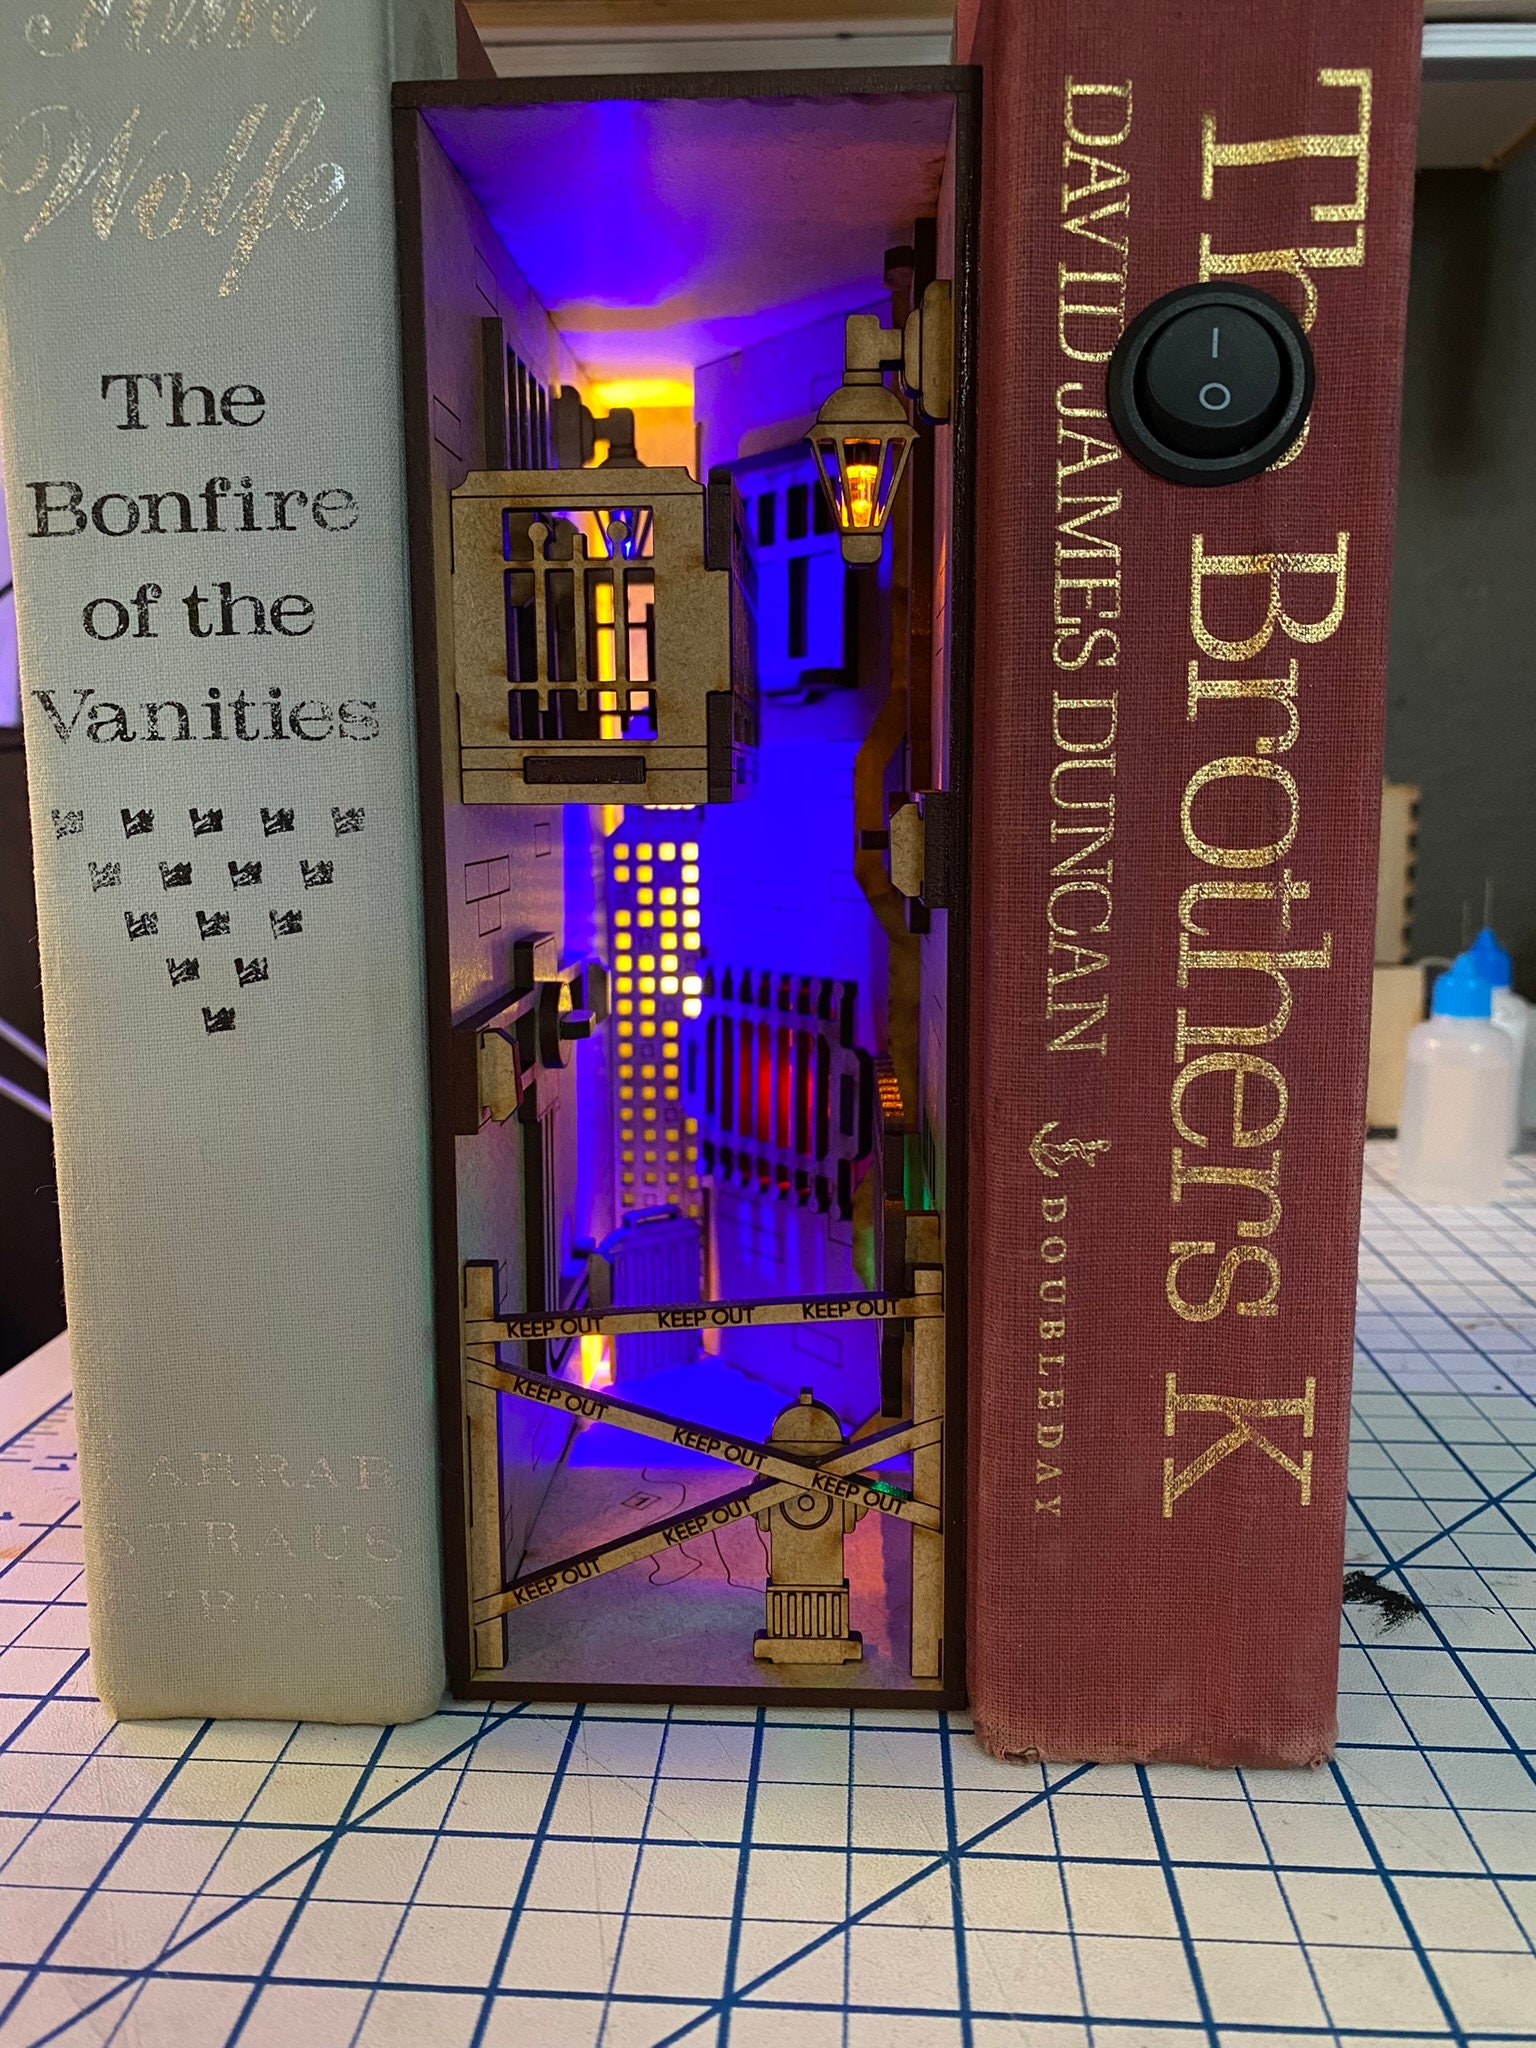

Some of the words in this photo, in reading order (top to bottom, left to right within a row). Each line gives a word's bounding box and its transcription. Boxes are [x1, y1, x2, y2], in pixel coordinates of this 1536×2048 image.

[1058, 75, 1132, 363] DAVID
[1199, 67, 1373, 473] Th
[101, 372, 267, 431] The
[26, 475, 360, 539] Bonfire
[1053, 383, 1122, 671] JAMES
[82, 582, 163, 641] of
[182, 581, 316, 639] the
[30, 686, 380, 744] Vanities
[1045, 690, 1119, 1056] DUNCAN
[1165, 531, 1350, 1322] Brothers
[506, 1320, 556, 1339] KEEP
[560, 1316, 604, 1336] OUT
[657, 1311, 709, 1329] KEEP
[713, 1306, 756, 1326] OUT
[801, 1302, 852, 1320] KEEP
[857, 1298, 900, 1317] OUT
[1034, 1196, 1068, 1517] DOUBLEDAY
[512, 1376, 562, 1404] KEEP
[565, 1394, 609, 1421] OUT
[97, 1450, 402, 1490] ARRAR
[672, 1427, 722, 1456] KEEP
[725, 1444, 768, 1471] OUT
[1162, 1373, 1316, 1518] K
[662, 1517, 712, 1547] KEEP
[710, 1497, 754, 1526] OUT
[811, 1473, 862, 1500] KEEP
[864, 1488, 907, 1516] OUT
[512, 1575, 560, 1605] KEEP
[560, 1557, 603, 1585] OUT
